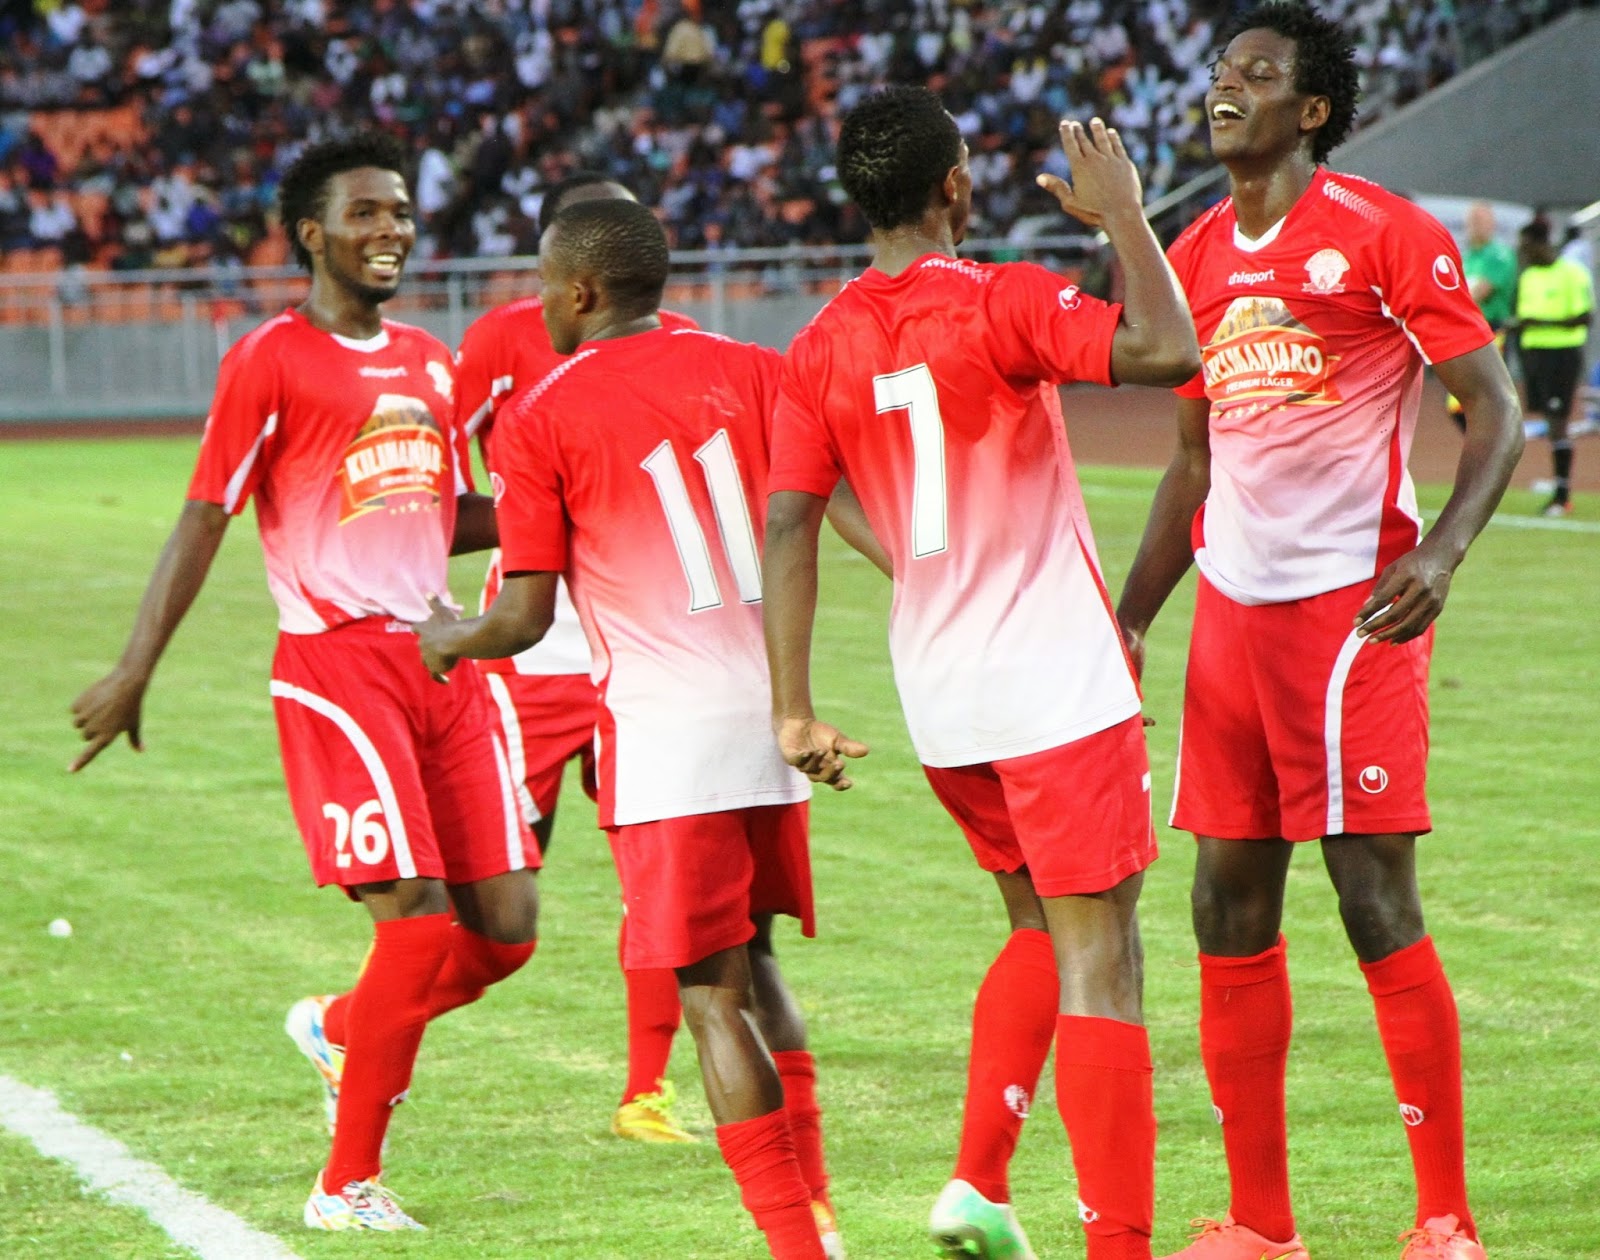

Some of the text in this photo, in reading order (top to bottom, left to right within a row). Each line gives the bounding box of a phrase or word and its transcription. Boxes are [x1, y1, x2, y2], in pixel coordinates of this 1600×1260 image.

[1228, 269, 1275, 286] uhlsport
[1262, 377, 1294, 387] LAGER
[873, 362, 947, 559] 7
[640, 428, 762, 615] 11
[322, 799, 389, 868] 26
